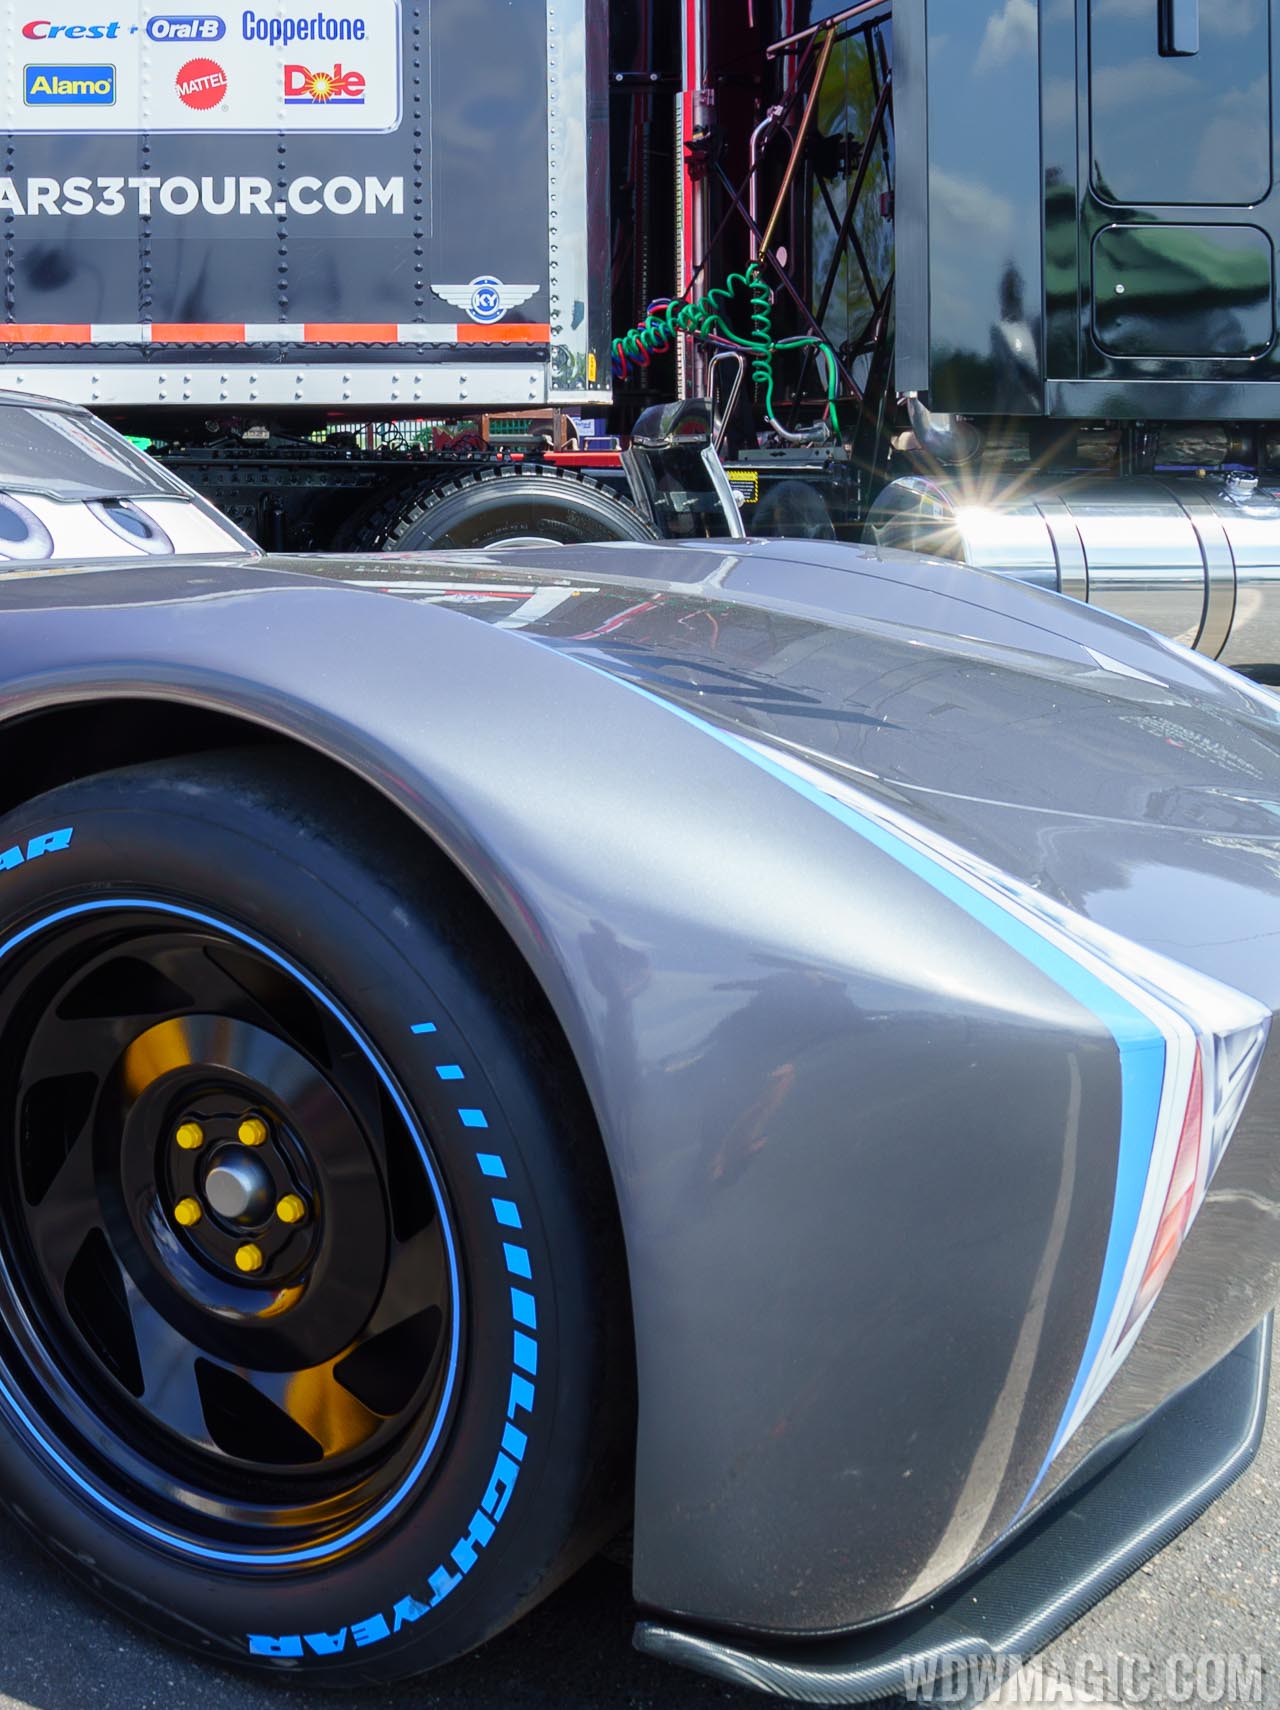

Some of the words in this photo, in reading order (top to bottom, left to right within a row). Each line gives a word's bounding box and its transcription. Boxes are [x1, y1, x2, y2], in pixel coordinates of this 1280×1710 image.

[21, 20, 120, 40] Crest
[151, 19, 219, 38] Oral-B
[242, 10, 365, 46] Coppertone
[30, 76, 110, 95] Alamo
[176, 73, 228, 96] MATTEL
[284, 64, 366, 99] Dole
[248, 1372, 535, 1656] LIGHTYEAR
